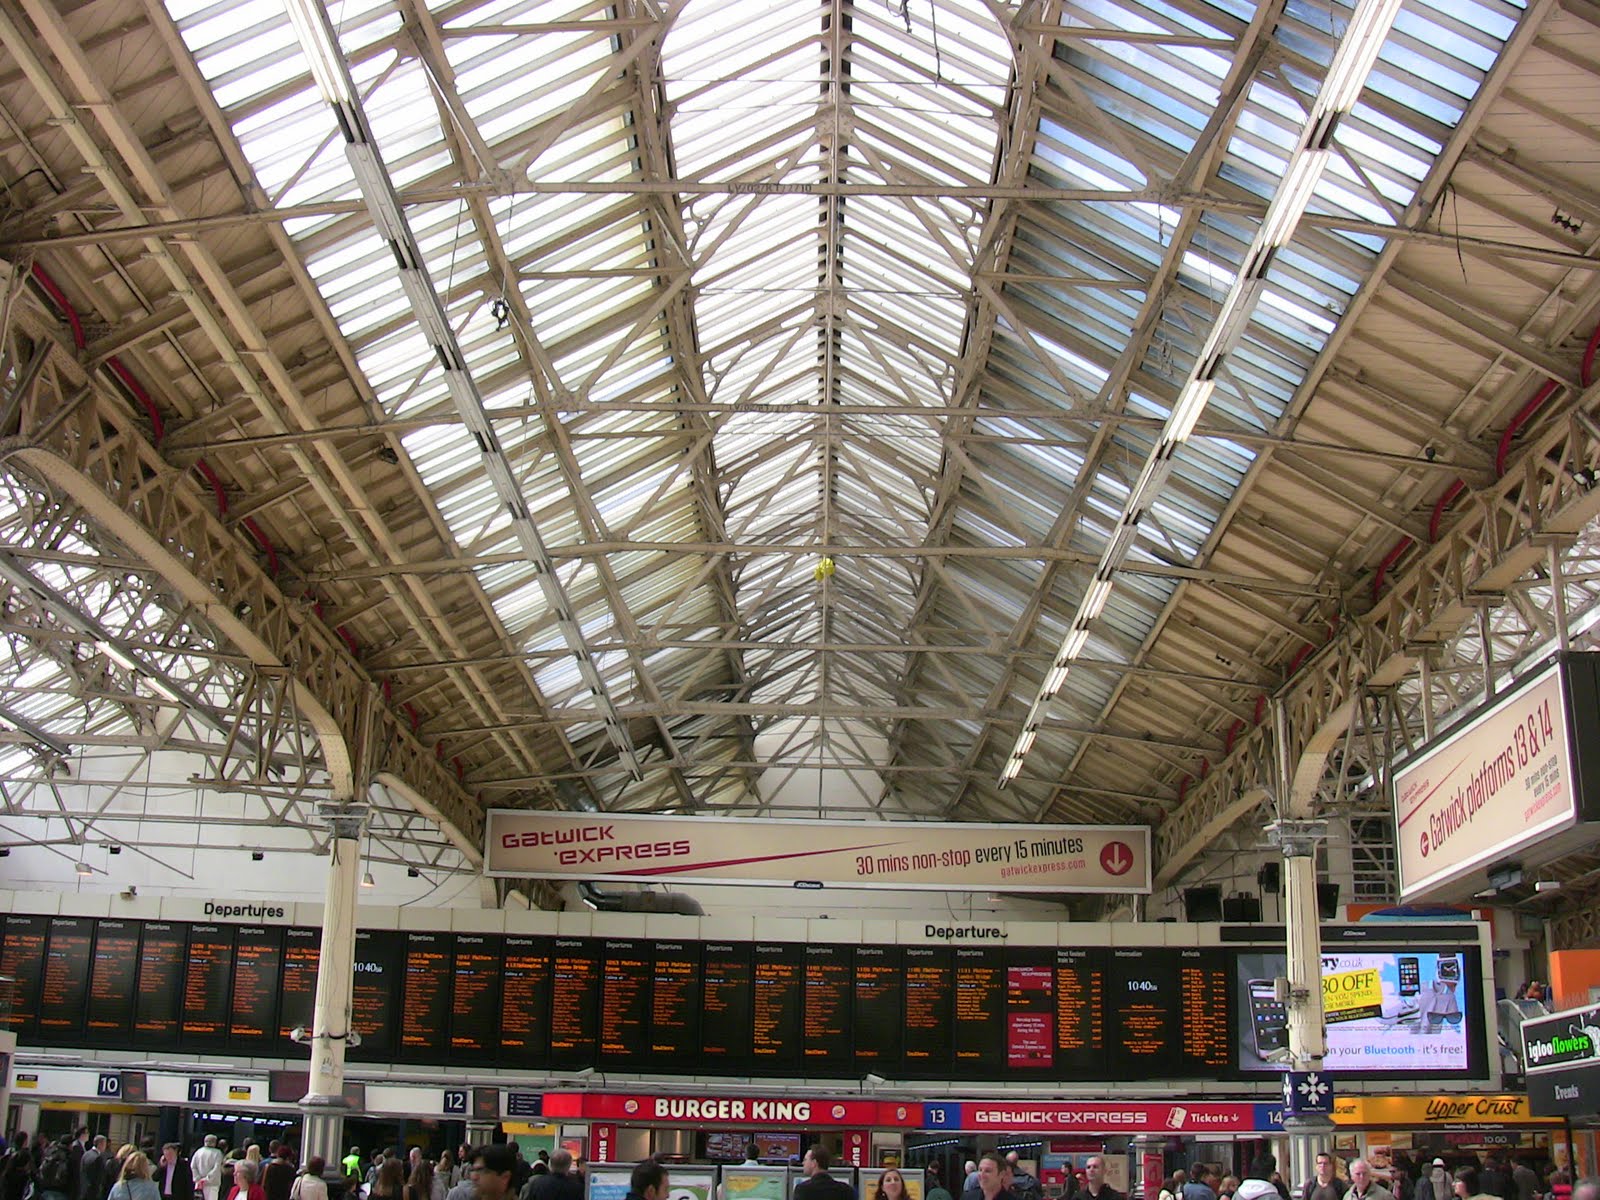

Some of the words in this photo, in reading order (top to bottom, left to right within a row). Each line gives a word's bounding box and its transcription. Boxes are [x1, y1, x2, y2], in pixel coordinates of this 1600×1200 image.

[1430, 787, 1467, 851] Gatwick
[1467, 744, 1515, 823] platforms
[1513, 723, 1528, 770] 13
[1527, 714, 1541, 758] &
[1538, 698, 1553, 747] 14
[856, 856, 873, 875] 30
[877, 852, 909, 873] mins
[913, 849, 971, 870] non-stop
[975, 844, 1011, 864] every
[1014, 840, 1028, 859] 15
[1031, 837, 1084, 857] minutes
[1001, 858, 1086, 878] gatwickexpress.com
[204, 902, 284, 918] Departures
[1339, 1047, 1361, 1056] your
[1364, 1045, 1414, 1055] Bluetooth
[1422, 1045, 1437, 1054] it's
[1440, 1044, 1463, 1054] free!
[101, 1077, 118, 1092] 10
[193, 1083, 206, 1098] 11
[1554, 1084, 1579, 1100] Events
[447, 1093, 464, 1108] 12
[1426, 1100, 1474, 1119] Upper
[1475, 1097, 1523, 1114] Crust
[655, 1099, 746, 1119] BURGER
[752, 1101, 811, 1121] KING
[930, 1110, 945, 1123] 13
[1191, 1112, 1229, 1123] Tickets
[1267, 1111, 1283, 1124] 14
